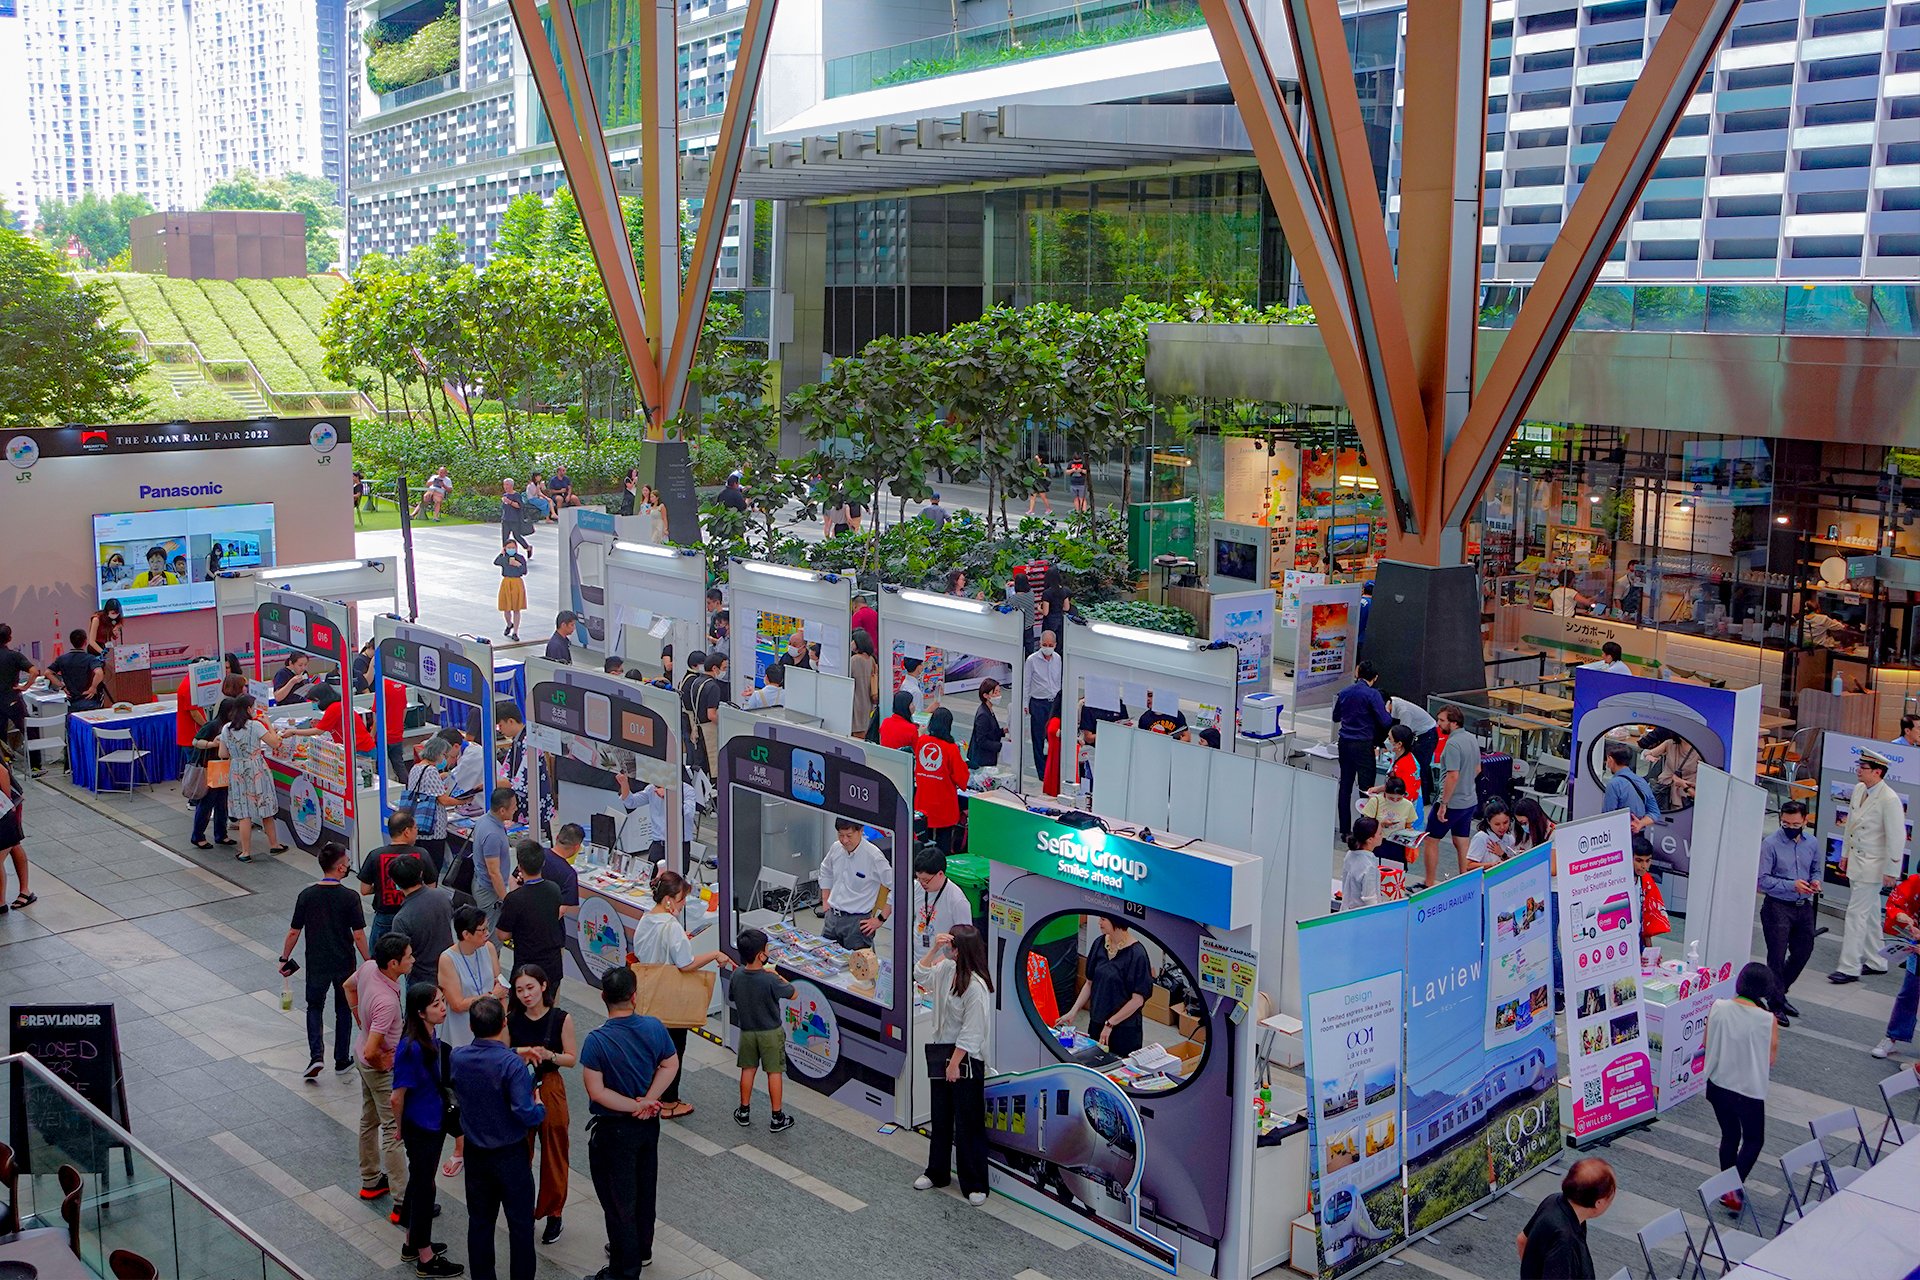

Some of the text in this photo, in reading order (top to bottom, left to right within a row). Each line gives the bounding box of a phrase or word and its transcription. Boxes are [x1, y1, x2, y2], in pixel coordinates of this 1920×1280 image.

[116, 430, 269, 445] THE JAPAN RAIL FAIR 2022
[318, 455, 331, 465] JR
[16, 472, 31, 480] JR
[139, 481, 223, 499] Panasonic
[270, 609, 279, 621] JR
[317, 632, 329, 643] 016
[1565, 622, 1615, 640] シンガポール
[394, 645, 406, 659] JR
[453, 672, 467, 685] 015
[551, 690, 567, 705] JR
[629, 722, 646, 736] 014
[750, 745, 769, 763] JR
[748, 774, 772, 787] SAPPORO
[849, 785, 869, 802] 013
[1590, 830, 1612, 847] mobi
[1037, 830, 1148, 881] Seibu Group
[1058, 860, 1123, 889] Smiles ahead
[1584, 869, 1612, 882] On-demand
[1571, 876, 1626, 896] Shared Shuttle Service
[1126, 901, 1143, 915] 012
[1427, 891, 1475, 918] SEIBU RAILWAY
[1411, 960, 1482, 1008] Laview
[1344, 990, 1372, 1006] Design
[1327, 1011, 1345, 1023] limited
[1346, 1008, 1364, 1019] express
[1365, 1003, 1373, 1012] like
[1378, 999, 1392, 1009] living
[20, 1014, 101, 1027] BREWLANDER
[1320, 1024, 1334, 1033] room
[1335, 1019, 1350, 1028] where
[1350, 1013, 1373, 1026] everyone
[1373, 1010, 1383, 1018] can
[1346, 1026, 1374, 1050] 001
[26, 1040, 98, 1060] CLOSED
[1346, 1046, 1375, 1061] Laview
[1349, 1058, 1371, 1070] EXTERIOR
[1506, 1101, 1546, 1146] 001
[1586, 1113, 1613, 1128] WILLERS
[1507, 1134, 1547, 1166] Laview
